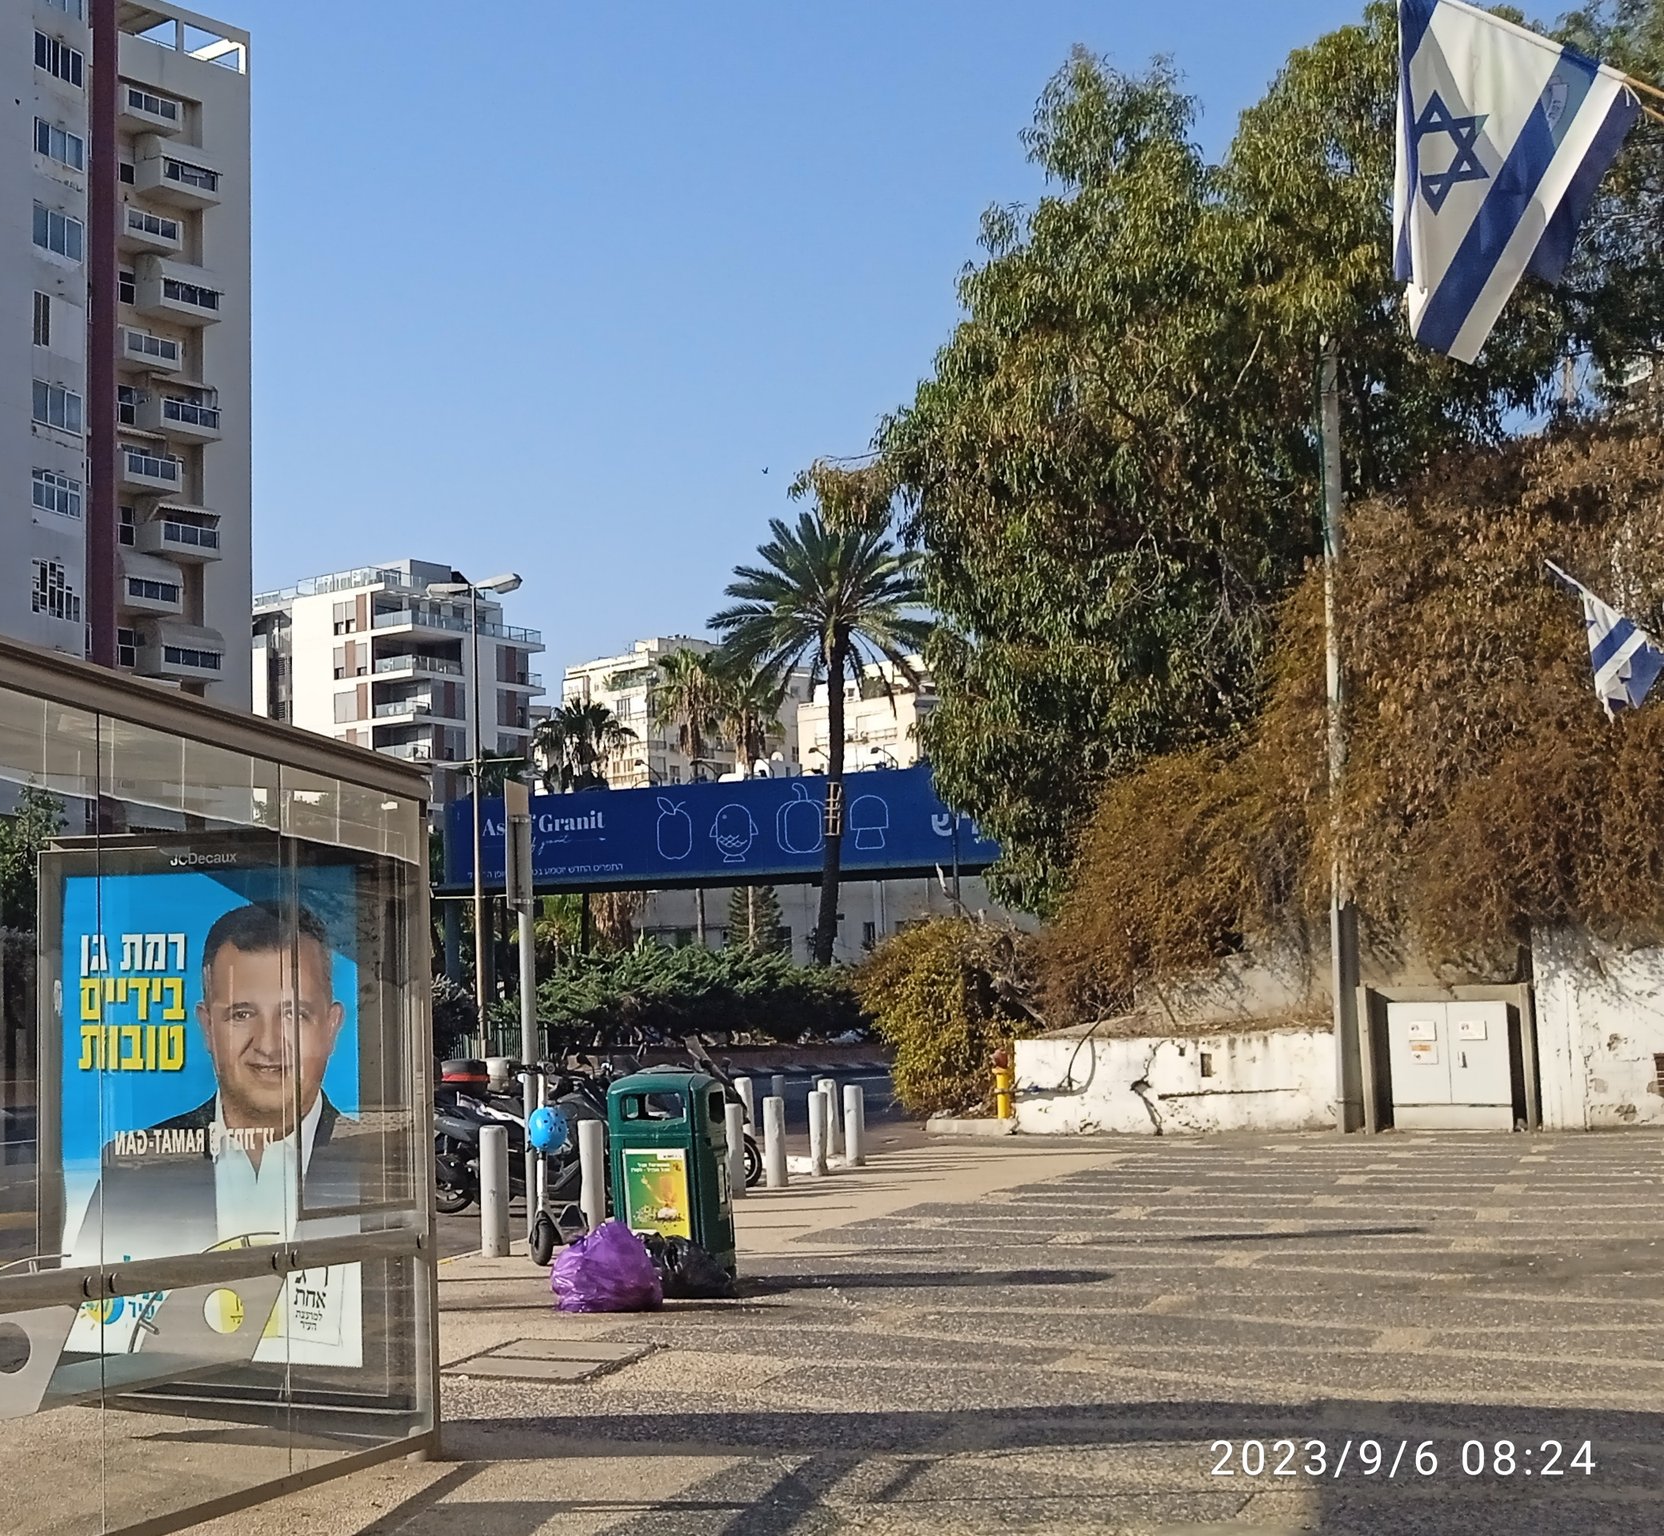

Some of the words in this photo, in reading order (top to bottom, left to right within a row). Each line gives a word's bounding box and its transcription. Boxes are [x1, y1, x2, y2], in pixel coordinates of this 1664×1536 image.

[538, 810, 606, 833] Granit
[169, 852, 238, 867] JCDecaux
[80, 934, 108, 975] גן
[120, 932, 186, 971] רמת
[78, 977, 186, 1021] בידיים
[78, 1024, 184, 1072] טובות
[293, 1287, 327, 1309] אחת
